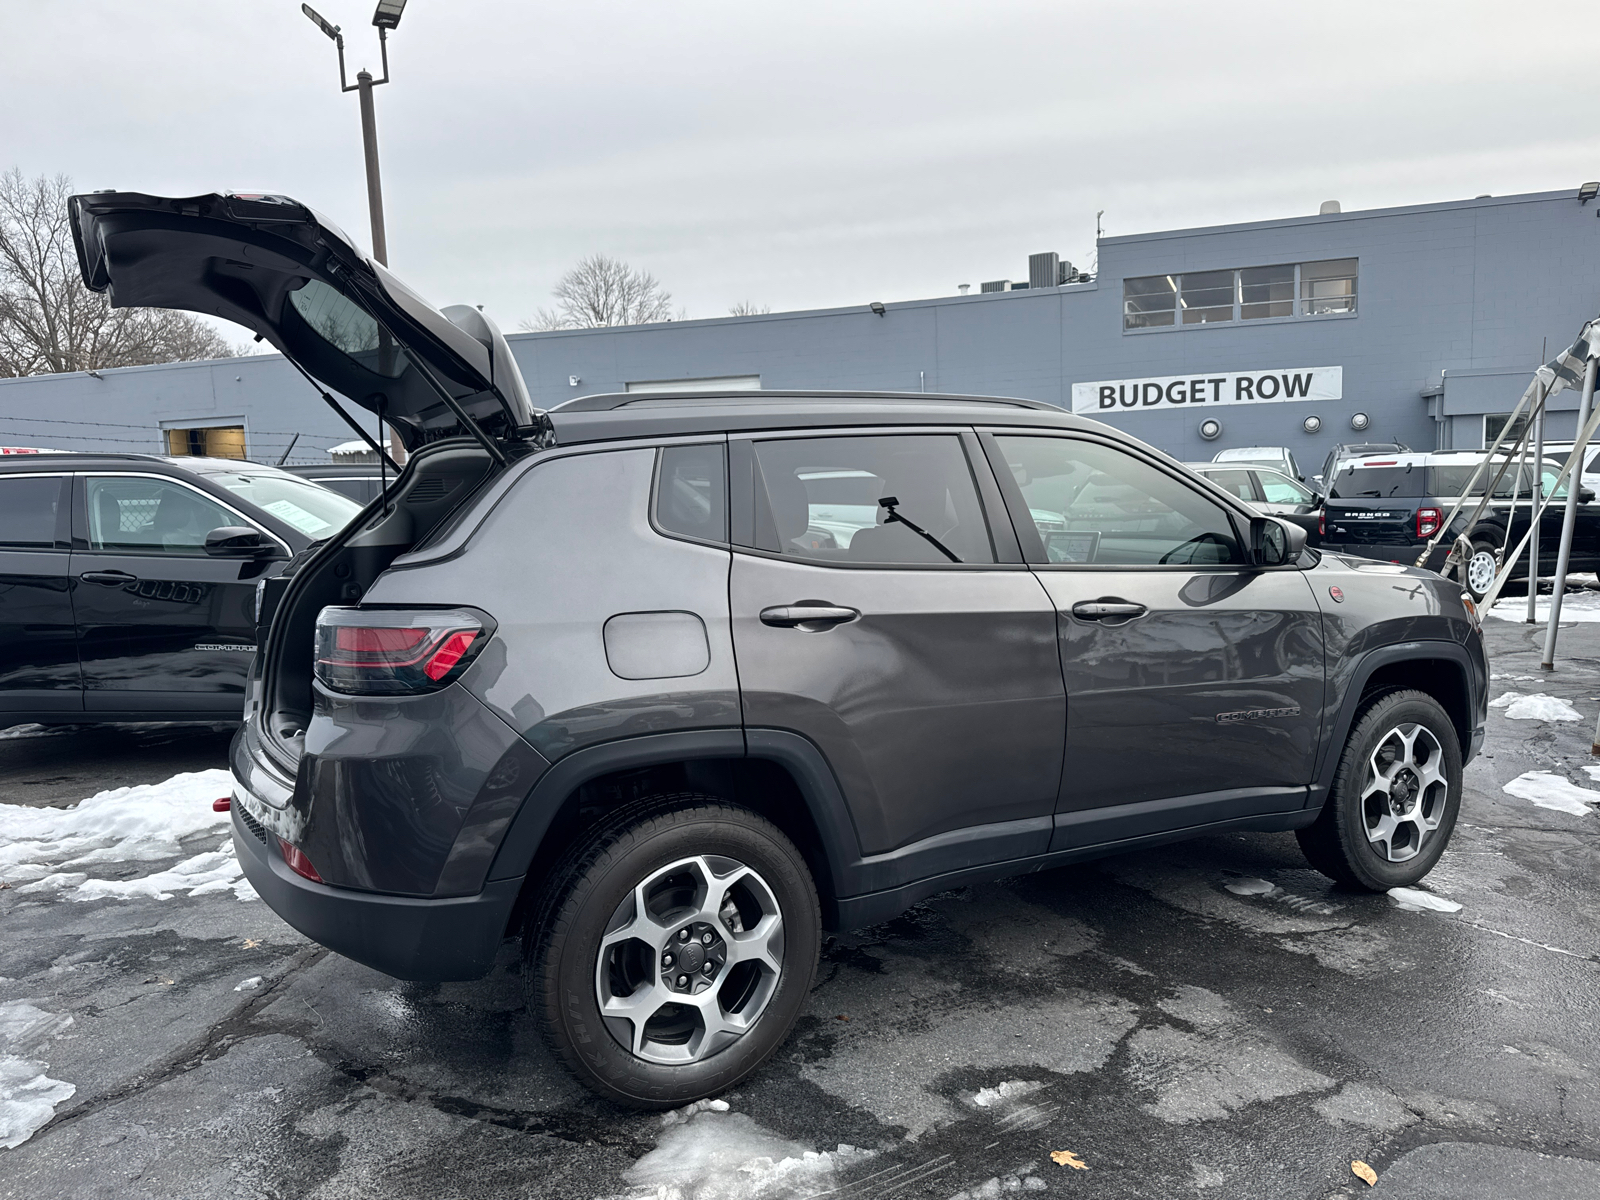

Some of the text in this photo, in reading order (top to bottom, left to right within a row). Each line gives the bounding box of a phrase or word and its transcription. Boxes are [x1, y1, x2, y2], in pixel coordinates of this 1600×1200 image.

[1099, 373, 1313, 409] BUDGET ROW
[194, 644, 258, 652] COMPAS
[1215, 706, 1300, 722] COMPASS
